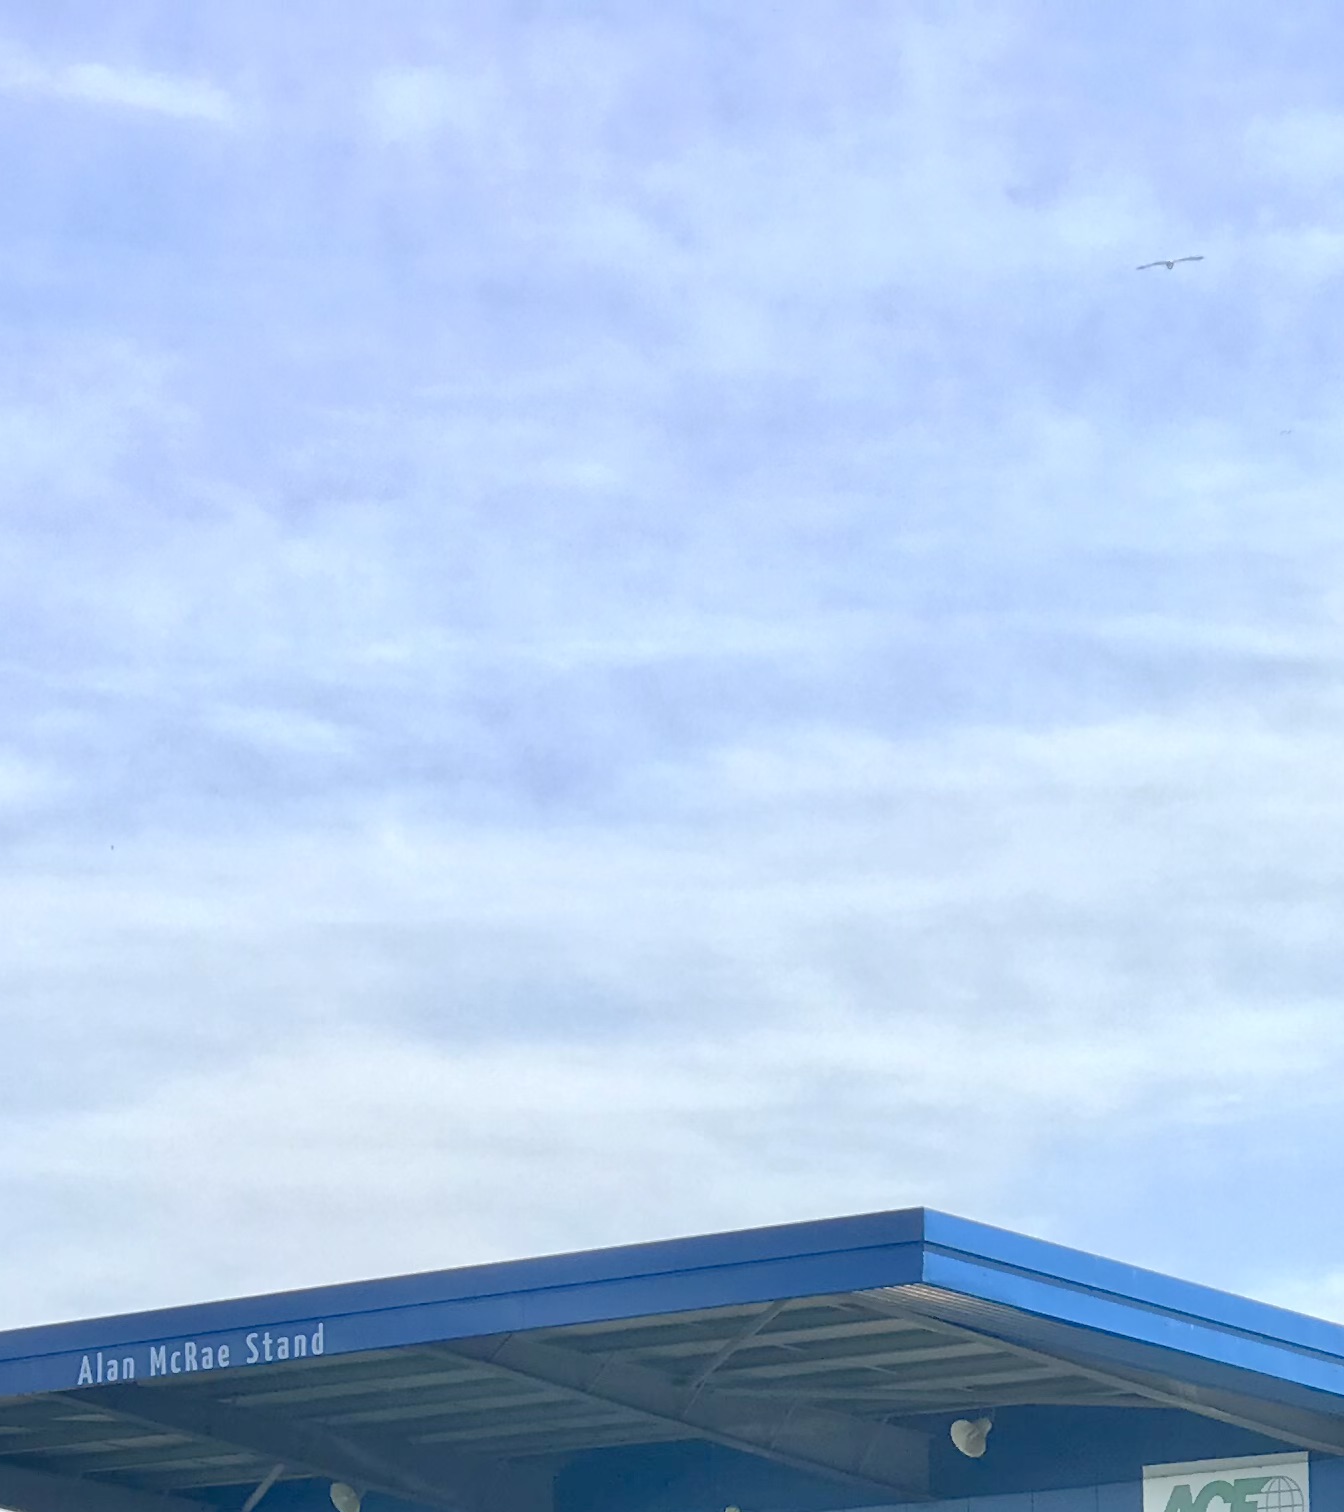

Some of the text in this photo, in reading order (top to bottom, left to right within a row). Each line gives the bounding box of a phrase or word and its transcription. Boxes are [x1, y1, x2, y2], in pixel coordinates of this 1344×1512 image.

[77, 1322, 324, 1385] Alan McRae Stand
